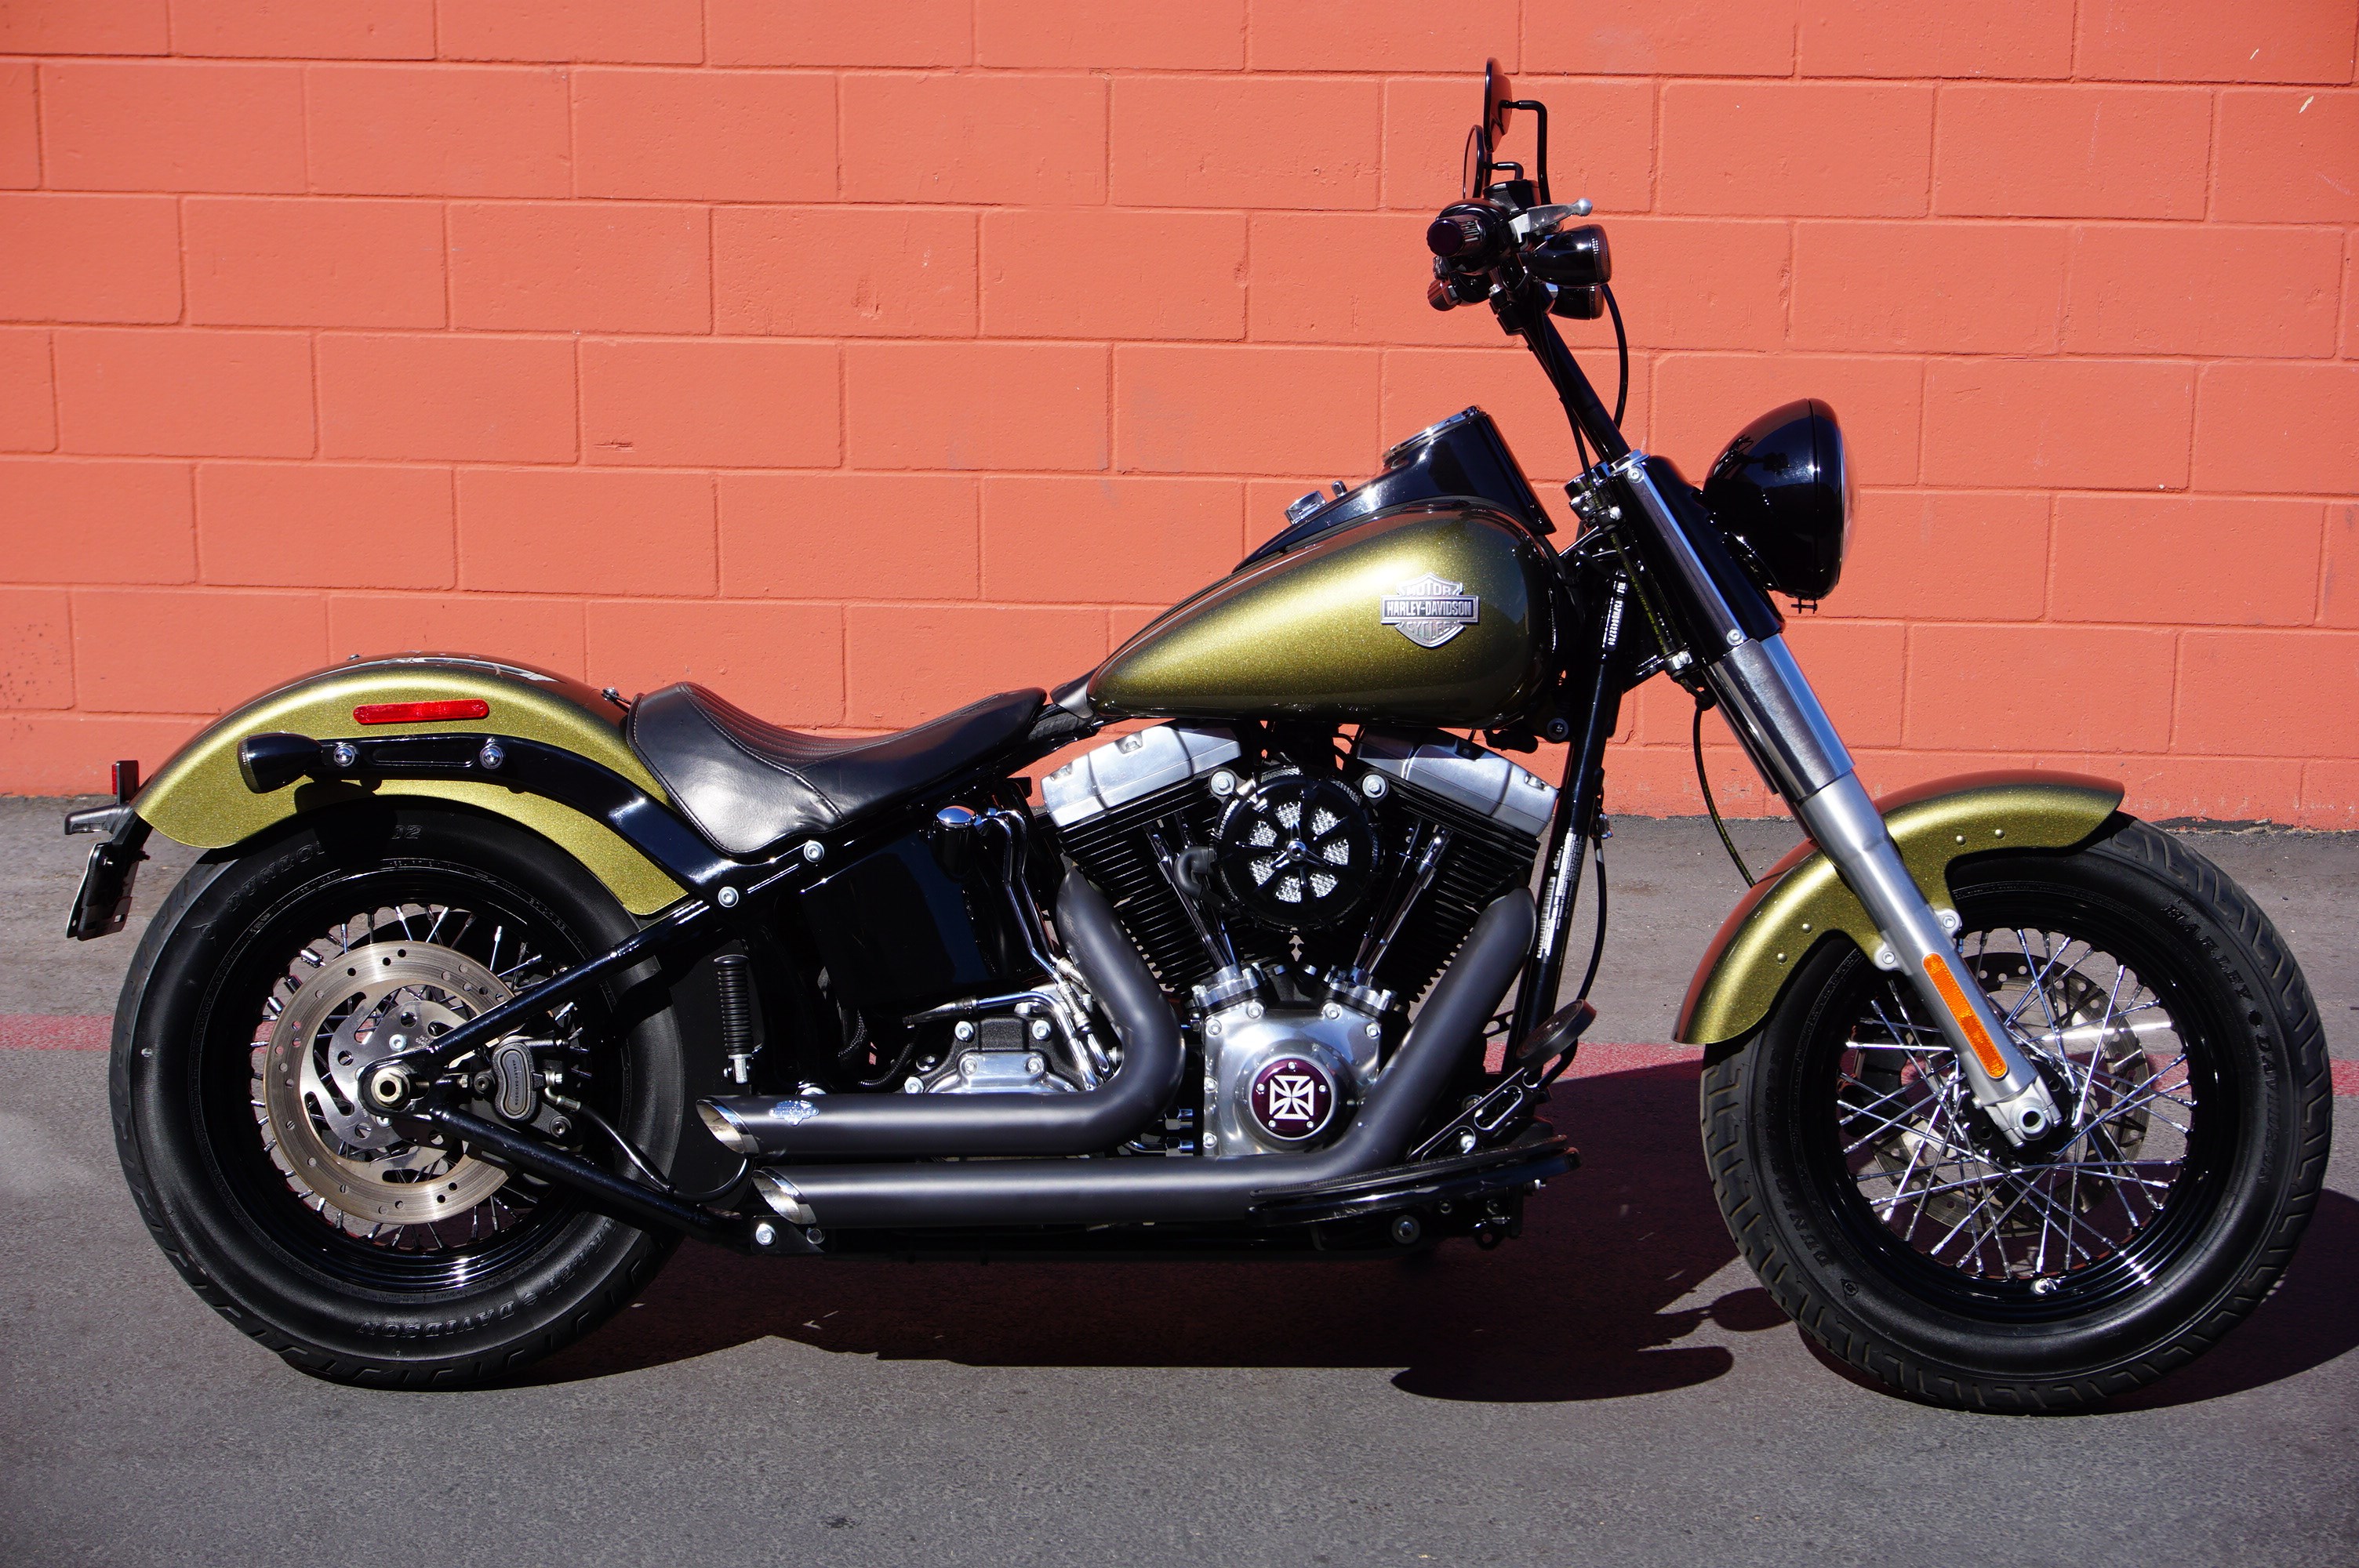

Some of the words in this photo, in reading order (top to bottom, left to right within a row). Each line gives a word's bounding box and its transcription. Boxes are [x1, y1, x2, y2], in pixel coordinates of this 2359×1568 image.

[1406, 583, 1452, 597] MOTOR
[1387, 601, 1472, 616] HARLEY-DAVIDSON
[1407, 621, 1453, 641] CYCLES
[2161, 904, 2255, 1002] HARLEY
[356, 1300, 517, 1338] DAVIDSON
